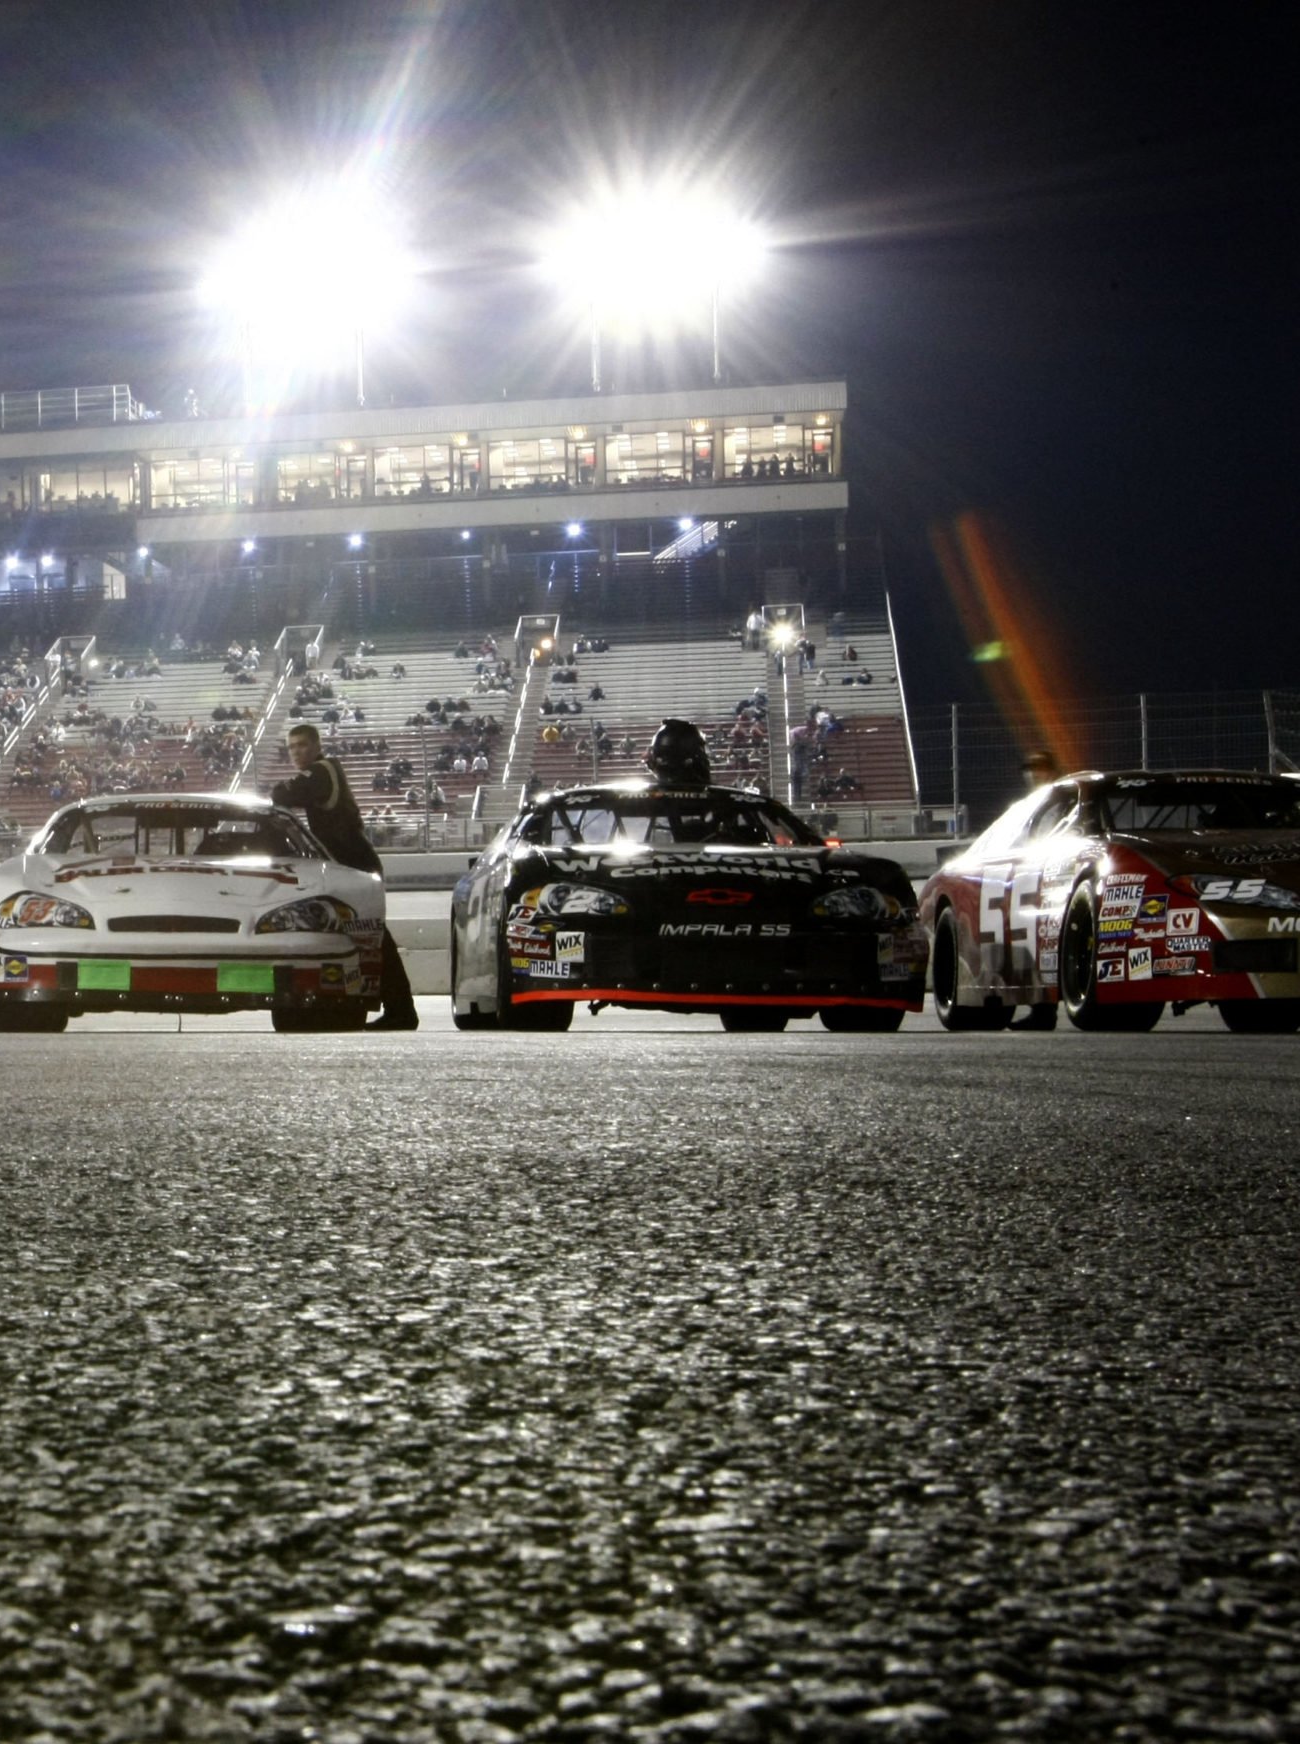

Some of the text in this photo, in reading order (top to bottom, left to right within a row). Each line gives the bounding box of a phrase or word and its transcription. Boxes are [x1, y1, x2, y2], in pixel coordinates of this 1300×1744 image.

[1175, 776, 1273, 786] PRO SERIES
[170, 802, 222, 810] SERIES
[611, 865, 812, 884] Computers
[1104, 887, 1142, 902] MAHLE
[1200, 879, 1267, 900] 55
[508, 905, 537, 921] JE
[979, 863, 1042, 970] 55
[1101, 905, 1130, 917] COMP
[344, 918, 384, 931] MAHLE
[1099, 920, 1133, 933] MOOG
[1172, 912, 1194, 929] CV
[658, 923, 792, 936] IMPALA SS
[557, 934, 582, 950] WIX
[1166, 937, 1211, 947] QUARTER
[1129, 948, 1150, 969] WIX
[531, 960, 569, 976] MAHLE
[1098, 960, 1122, 980] JE
